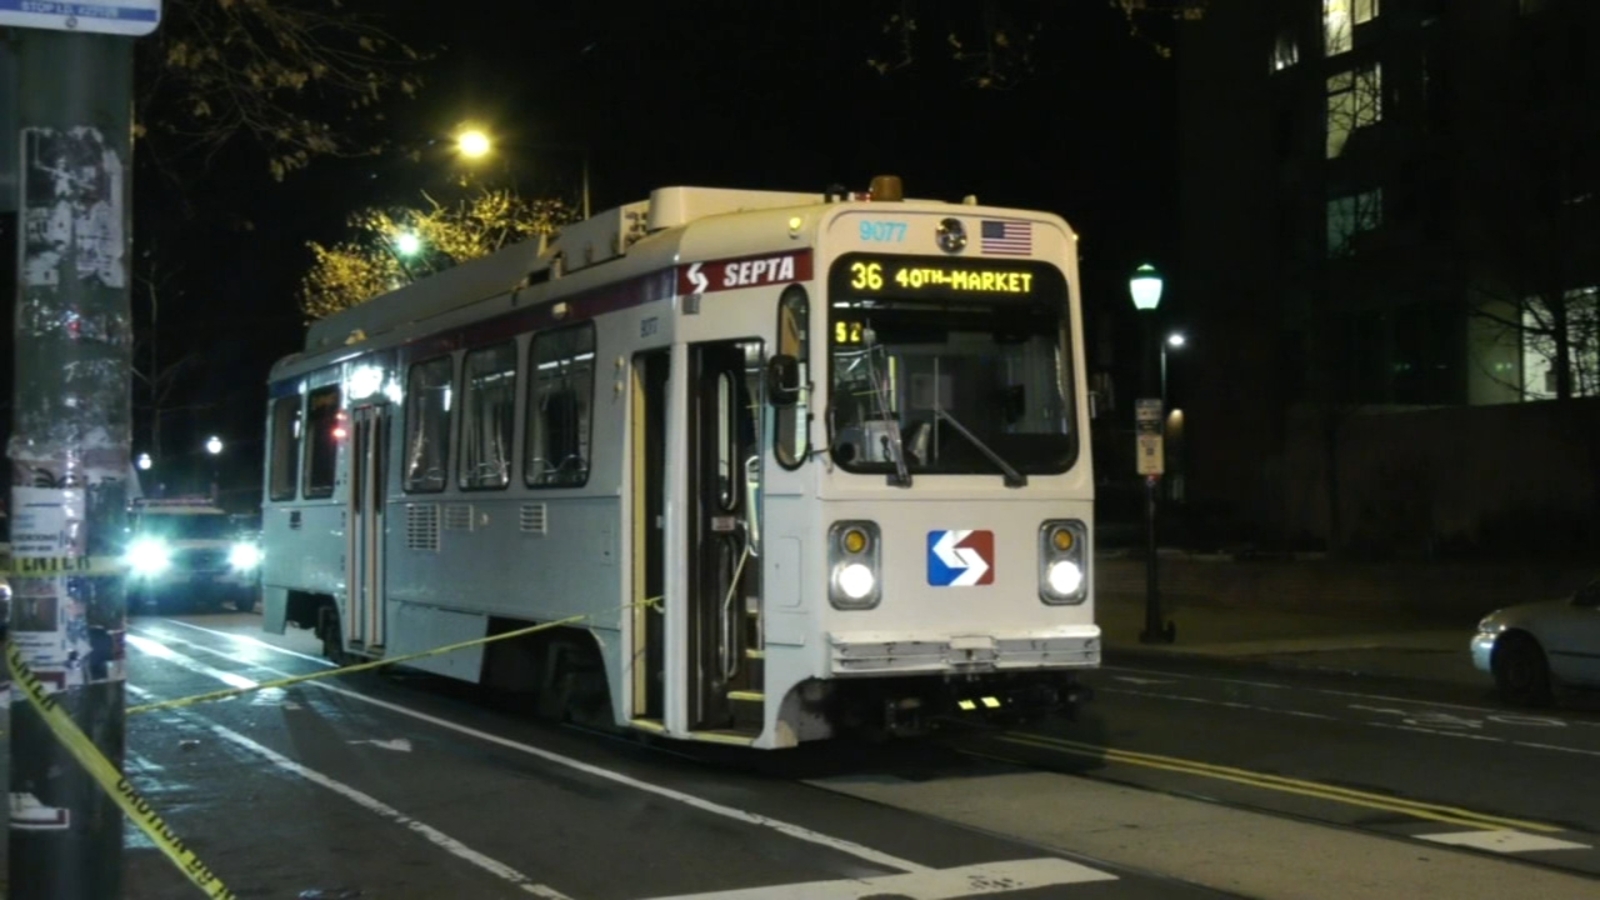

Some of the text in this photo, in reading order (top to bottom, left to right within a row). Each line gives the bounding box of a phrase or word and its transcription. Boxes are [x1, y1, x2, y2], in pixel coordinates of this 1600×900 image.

[860, 220, 908, 243] 9077
[723, 256, 795, 287] SEPTA
[851, 262, 883, 290] 36
